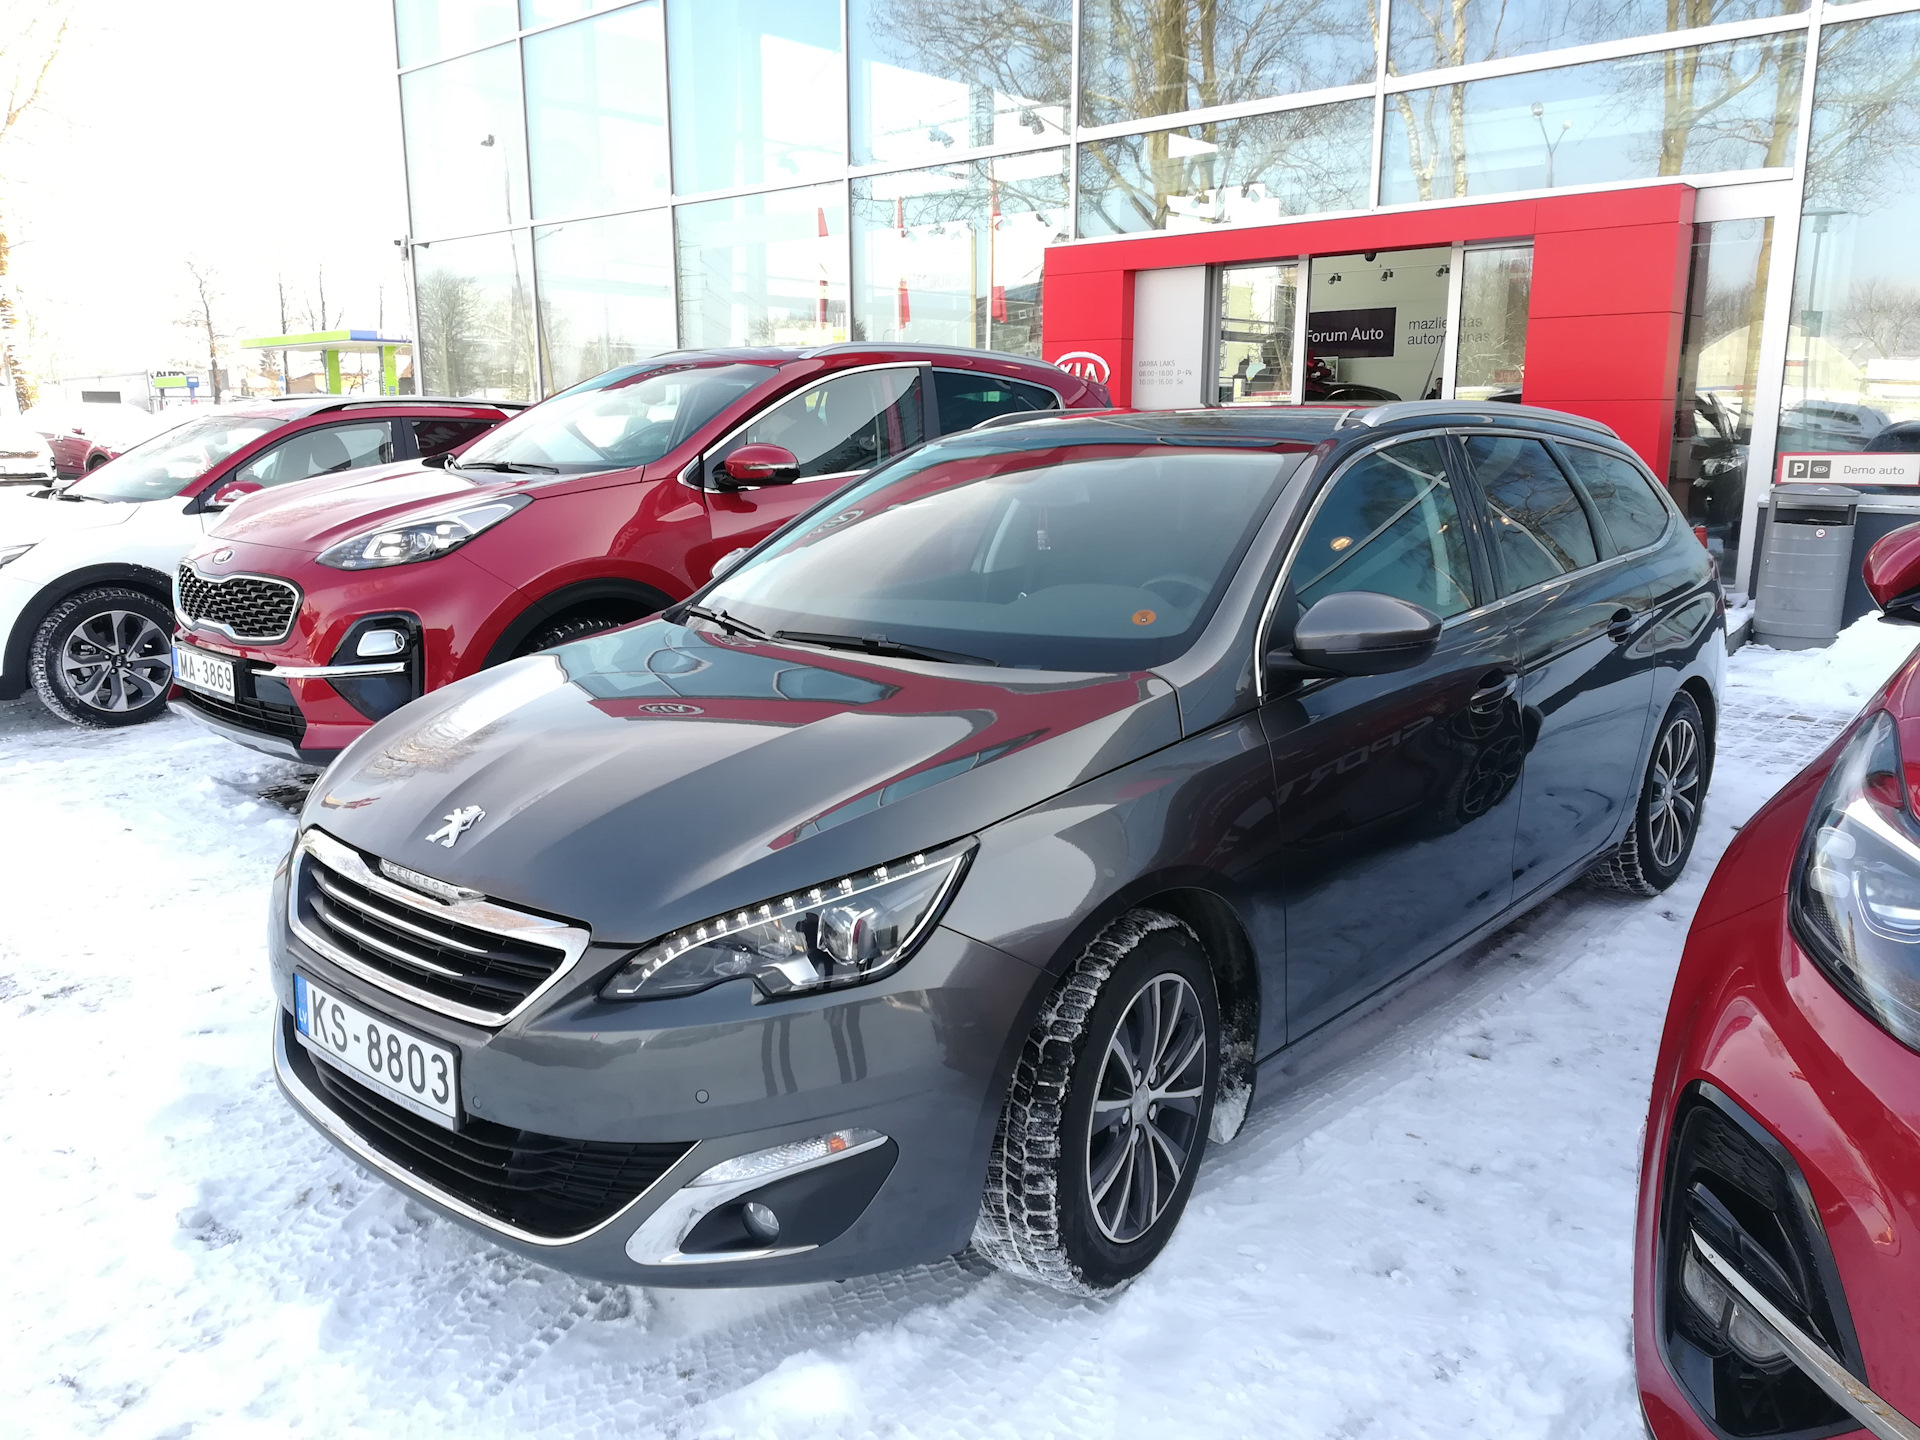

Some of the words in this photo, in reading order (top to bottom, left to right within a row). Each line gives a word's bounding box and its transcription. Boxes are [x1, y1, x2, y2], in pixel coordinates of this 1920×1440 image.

[1308, 329, 1347, 342] Forum
[1350, 327, 1384, 340] Auto
[1060, 362, 1099, 383] KIA
[1793, 462, 1805, 475] P
[1843, 465, 1875, 475] Demo
[1878, 466, 1905, 475] auto
[180, 653, 232, 691] MA-3869
[388, 864, 450, 893] PEUGEOT
[298, 1007, 308, 1024] LV
[311, 989, 450, 1105] KS-8803
